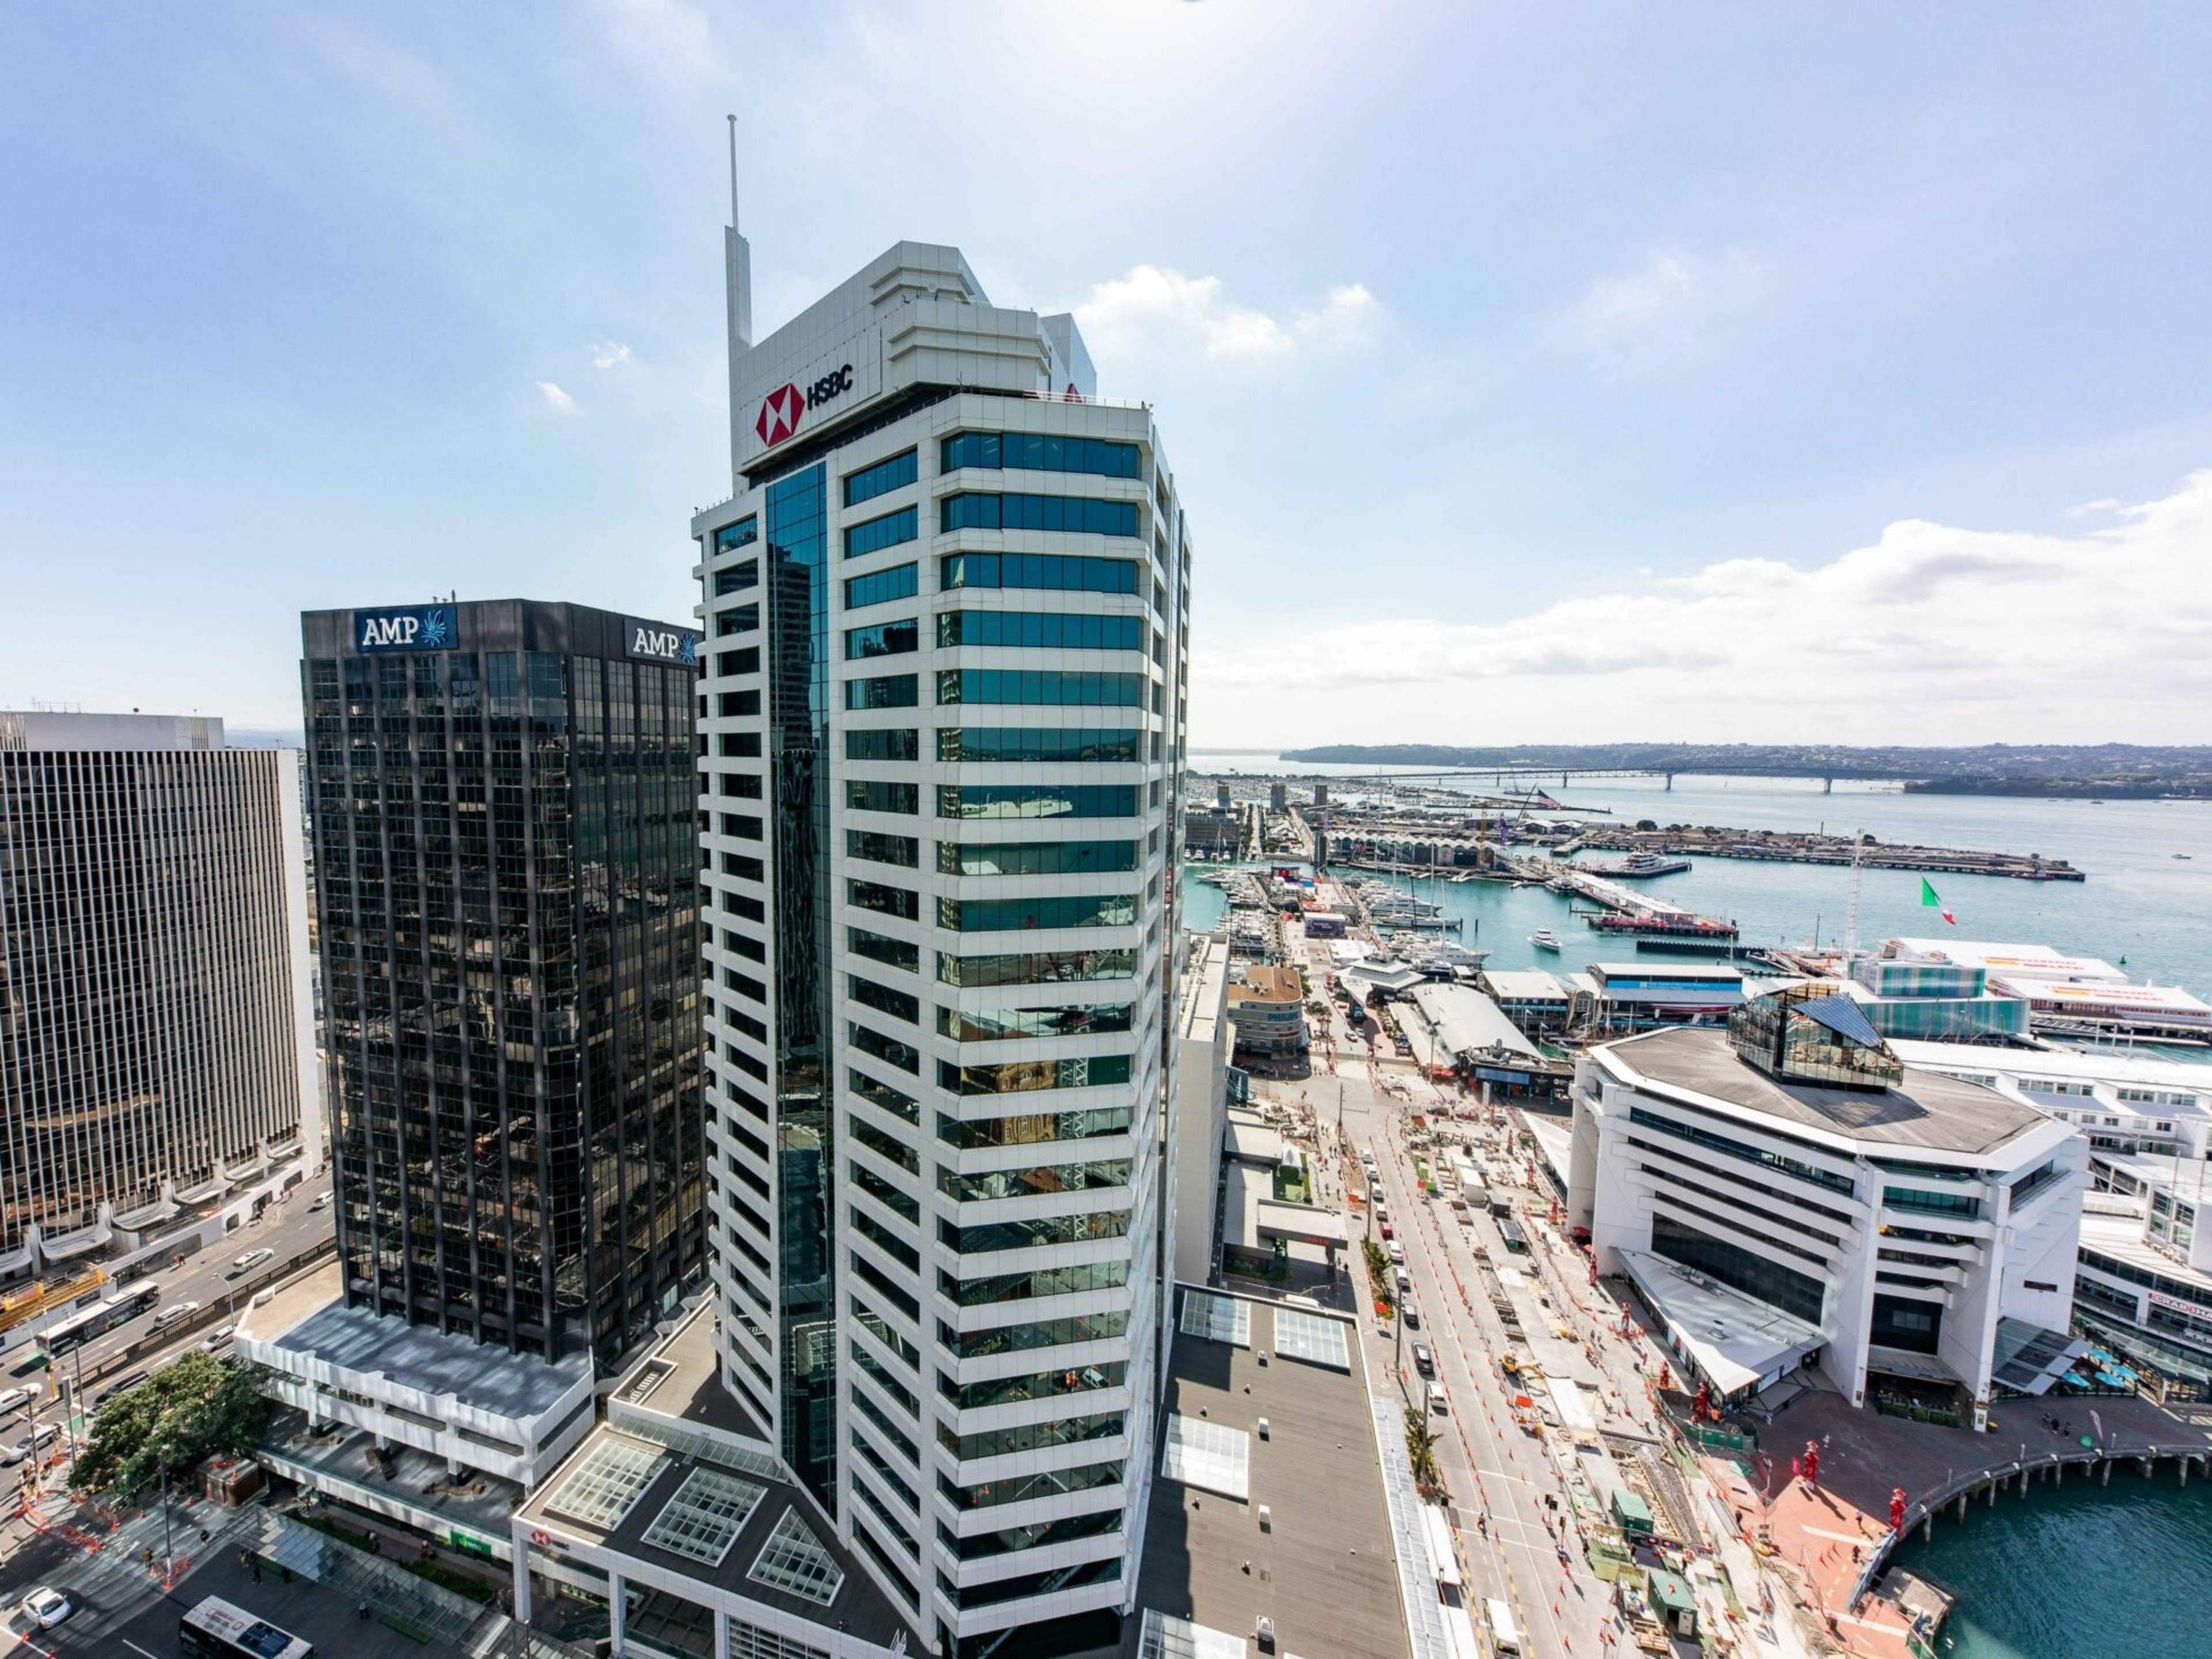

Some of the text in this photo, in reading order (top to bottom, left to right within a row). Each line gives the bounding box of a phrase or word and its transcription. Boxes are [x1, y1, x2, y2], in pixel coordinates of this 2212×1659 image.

[807, 363, 853, 411] HSBC
[362, 616, 419, 646] AMP
[633, 627, 679, 658] AMP
[2154, 1294, 2189, 1311] CRAB
